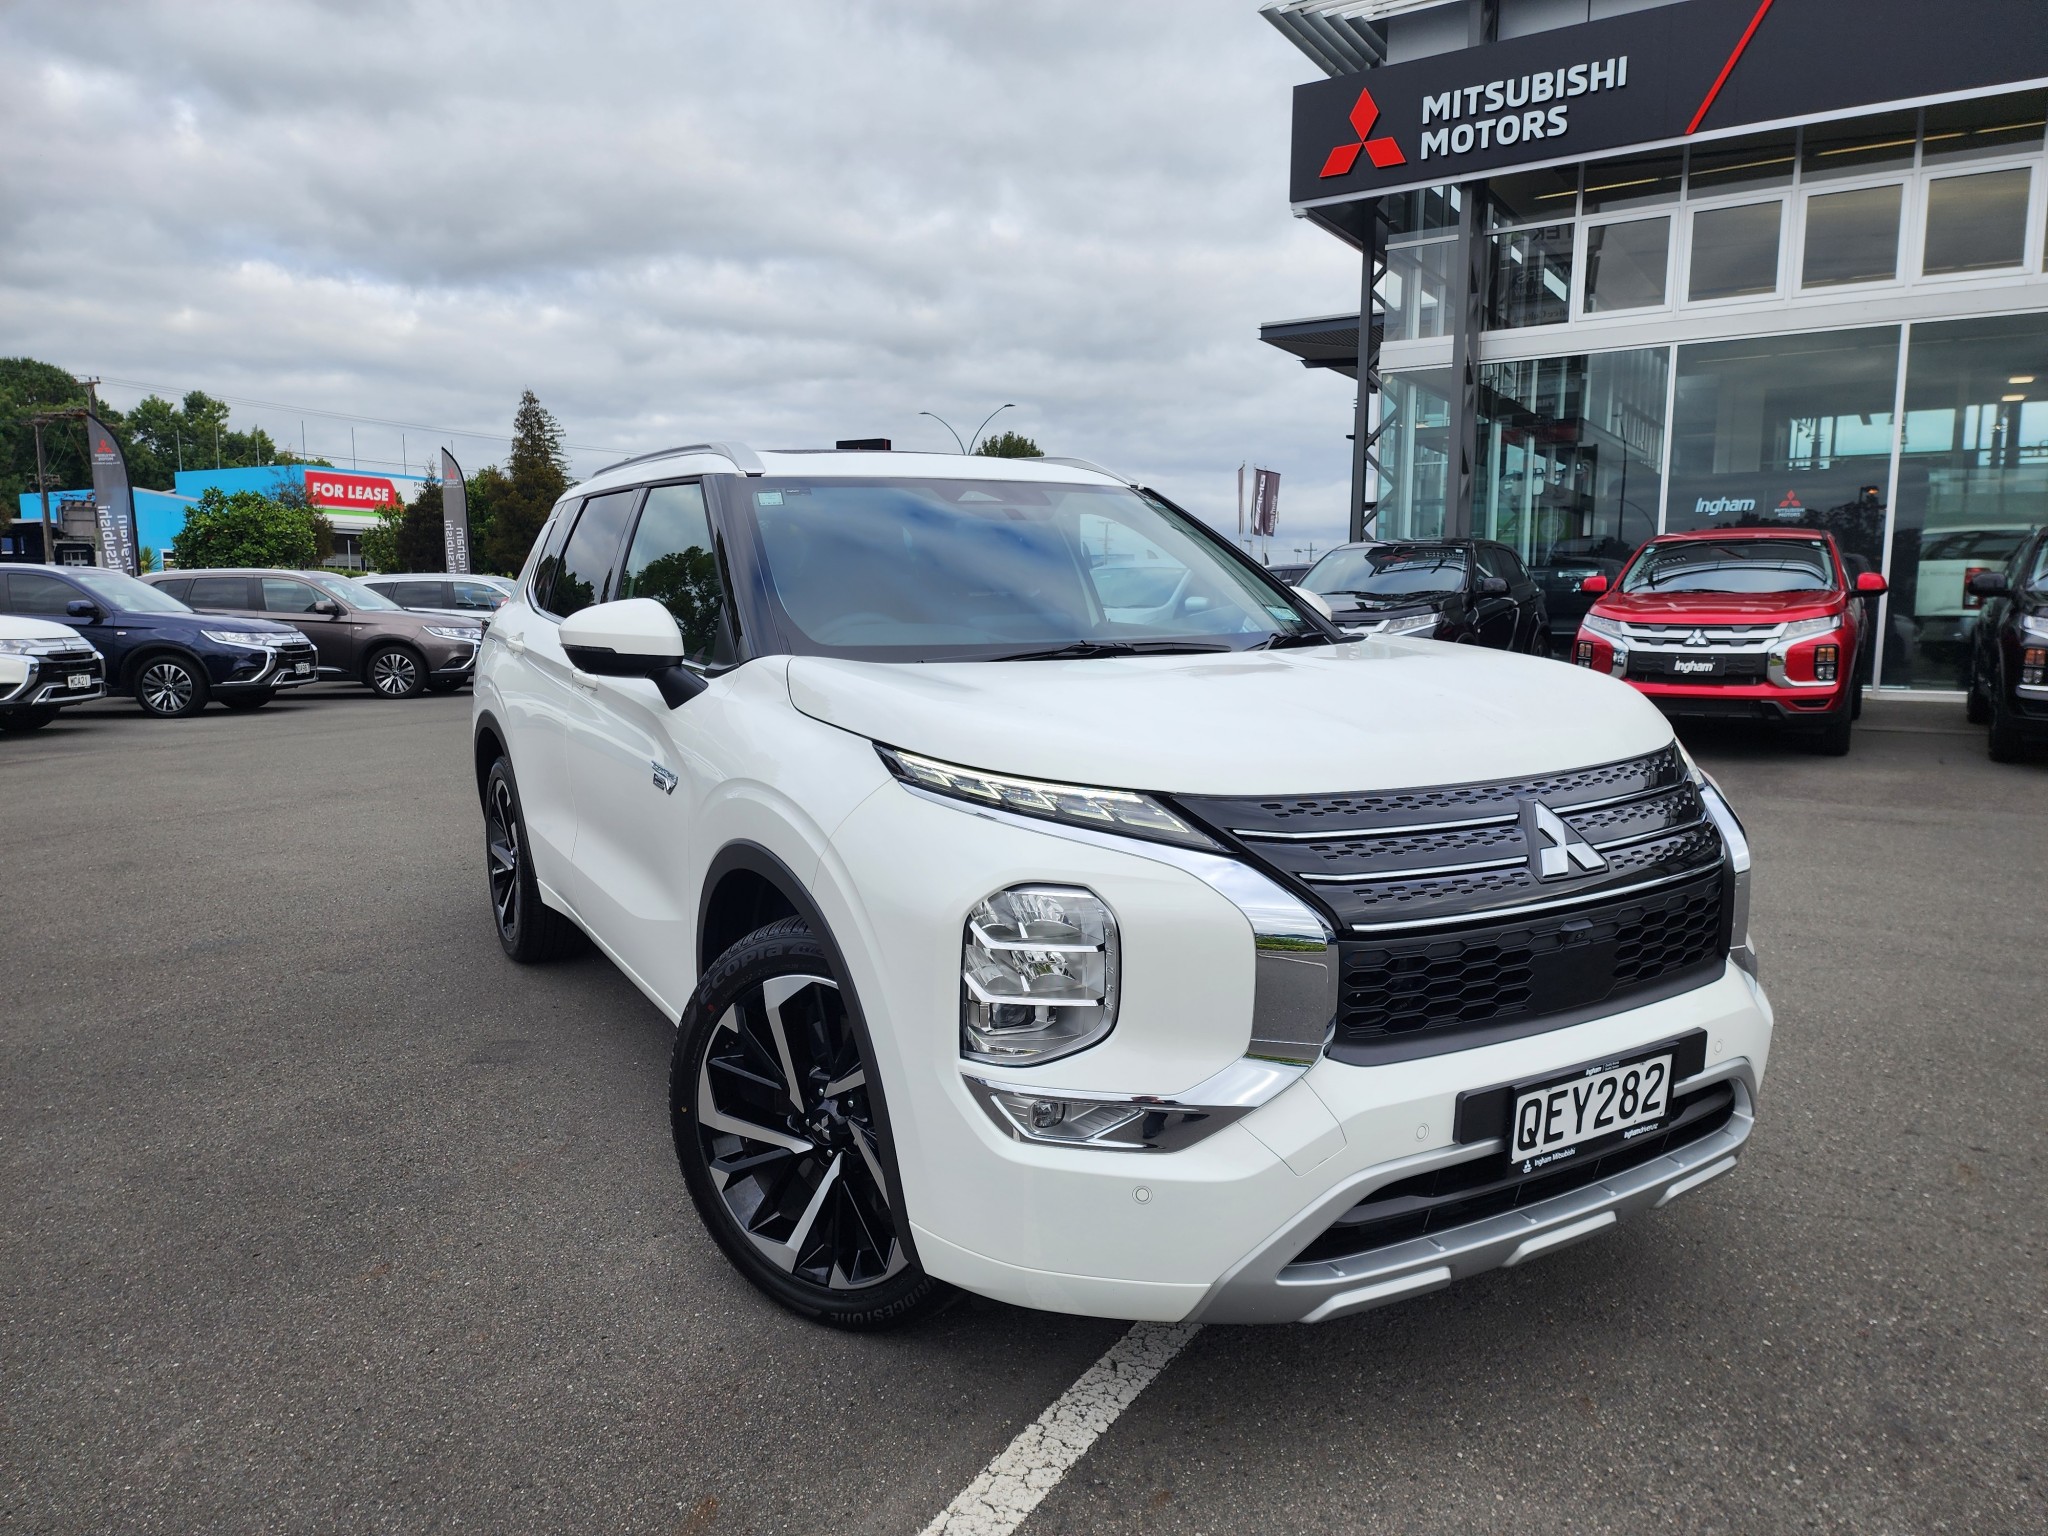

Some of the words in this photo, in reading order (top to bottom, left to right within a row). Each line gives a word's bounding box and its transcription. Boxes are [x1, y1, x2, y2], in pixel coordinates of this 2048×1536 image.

[1422, 56, 1628, 124] MITSUBISHI
[1420, 105, 1568, 160] MOTORS
[312, 482, 344, 498] FOR
[347, 485, 389, 501] LEASE
[1695, 496, 1756, 516] Ingham
[1674, 660, 1713, 674] Ingham
[1517, 1062, 1665, 1151] QEY282
[1534, 1156, 1552, 1167] Ingham
[1552, 1147, 1576, 1161] Mitsubishi
